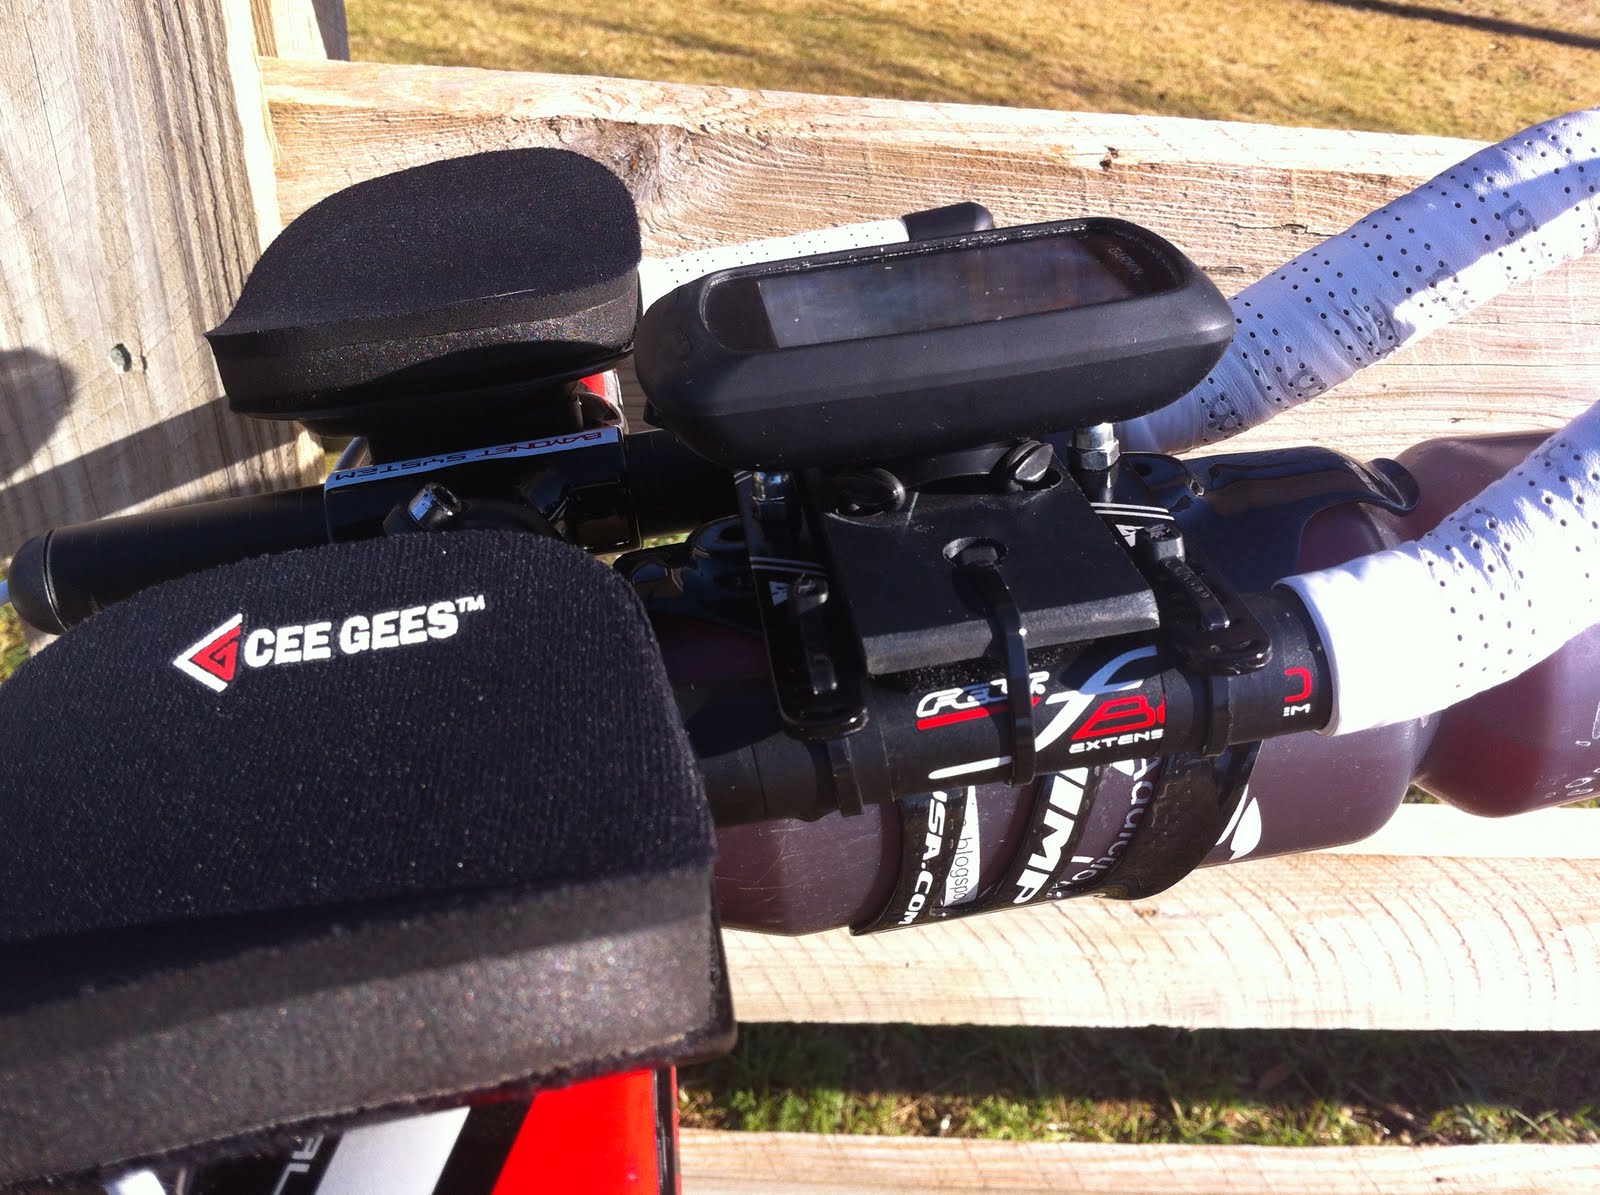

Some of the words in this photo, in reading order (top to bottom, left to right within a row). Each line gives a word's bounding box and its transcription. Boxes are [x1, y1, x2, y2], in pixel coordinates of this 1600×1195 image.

[476, 431, 603, 457] BAYONET
[336, 455, 467, 481] SYSTEM
[244, 620, 332, 668] CEE
